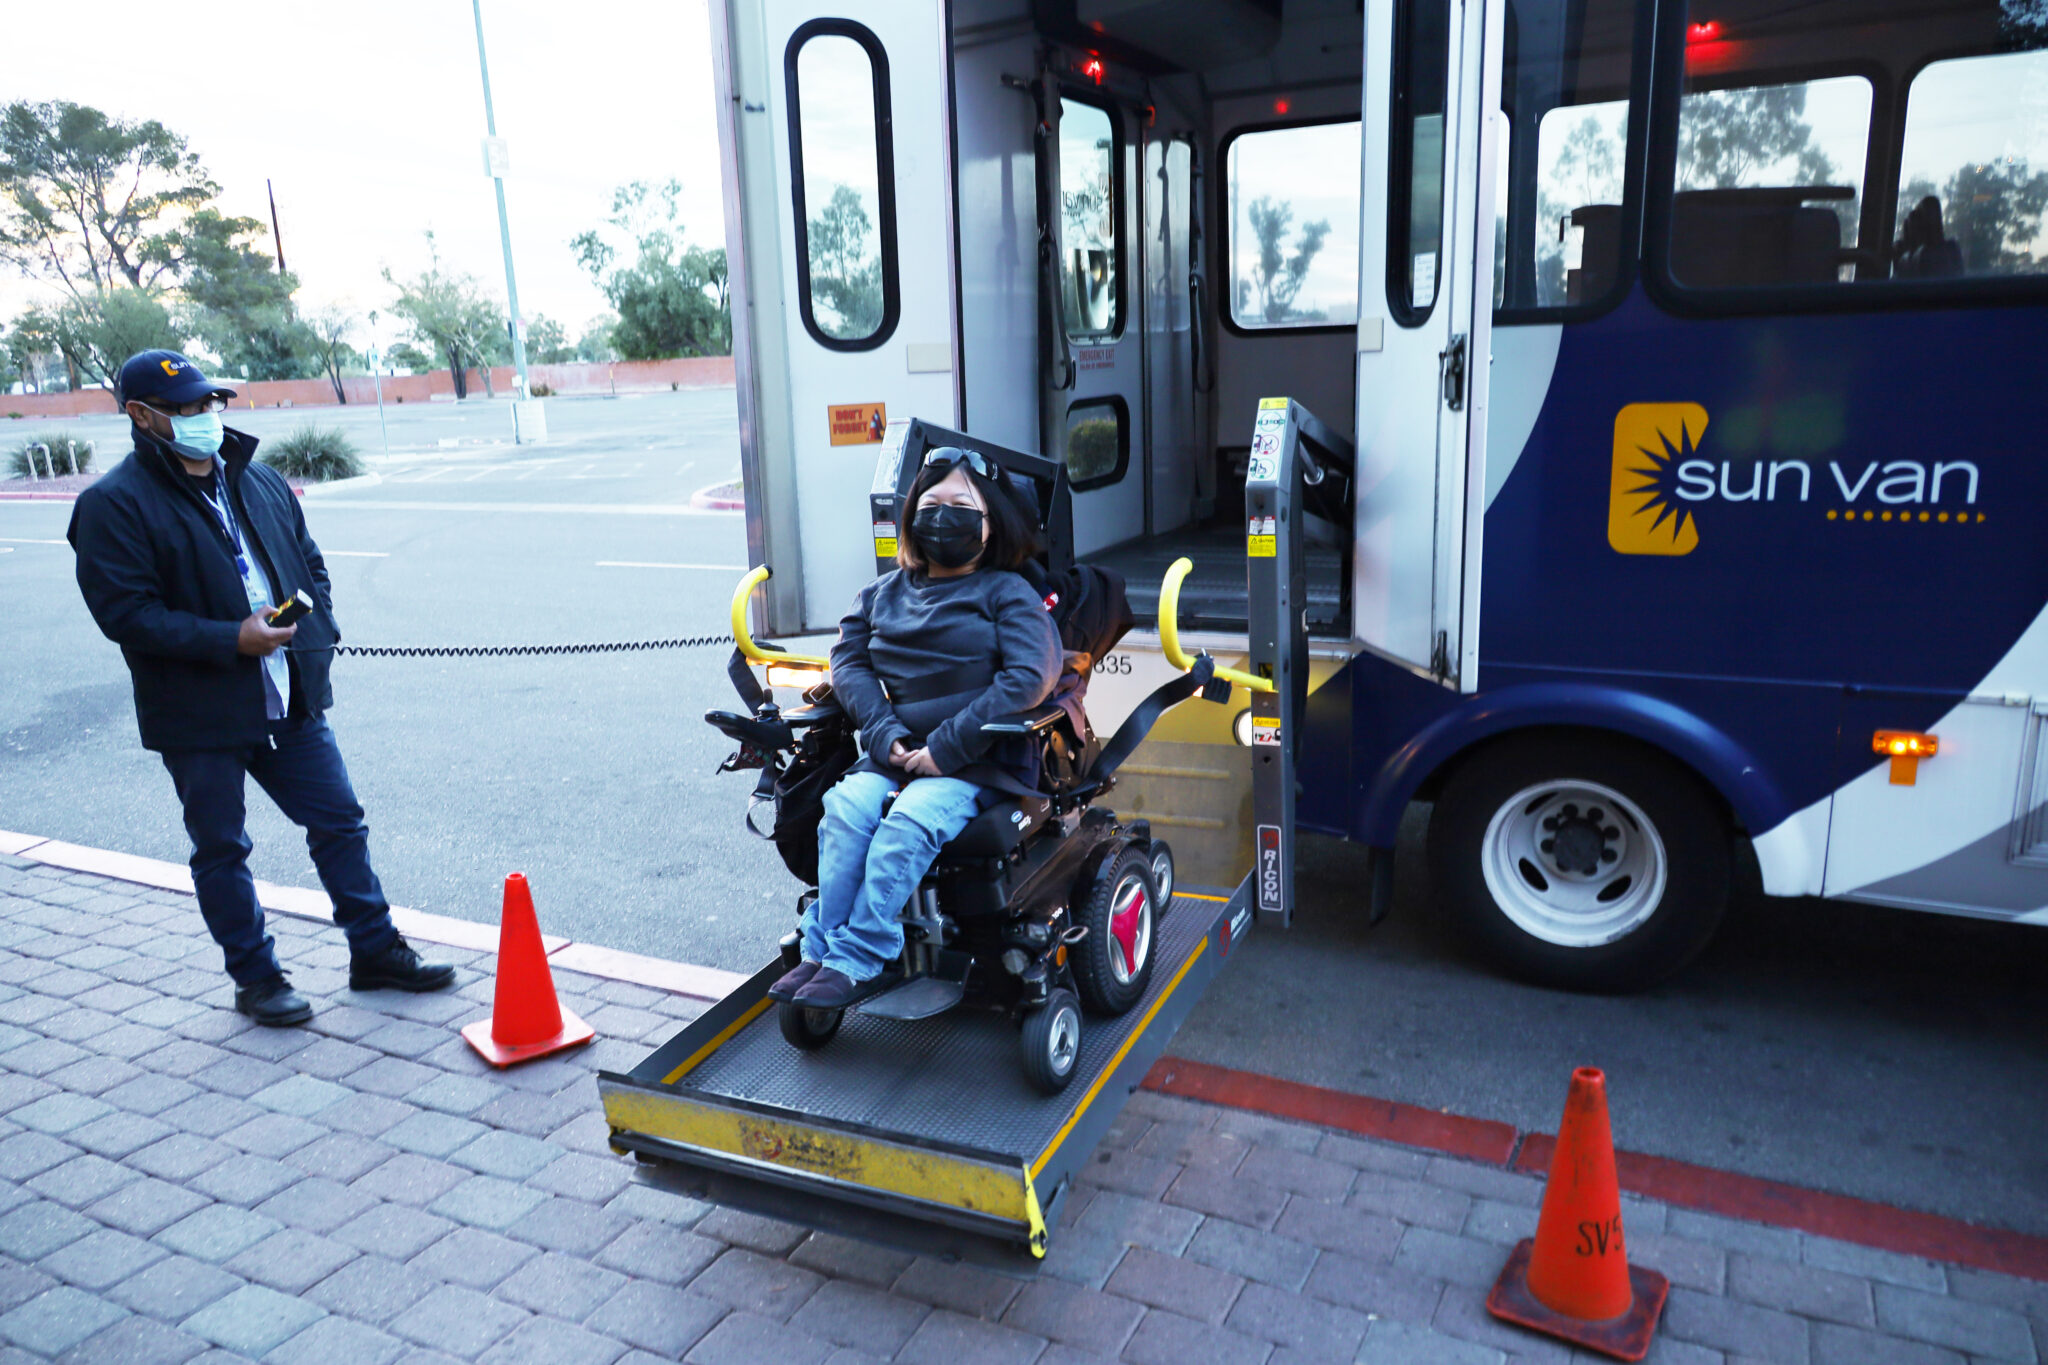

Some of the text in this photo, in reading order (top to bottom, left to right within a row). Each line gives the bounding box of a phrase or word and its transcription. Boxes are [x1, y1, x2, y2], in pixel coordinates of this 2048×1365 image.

[833, 421, 868, 434] FORGET
[1675, 460, 1980, 504] sun van
[1264, 849, 1278, 902] RICON
